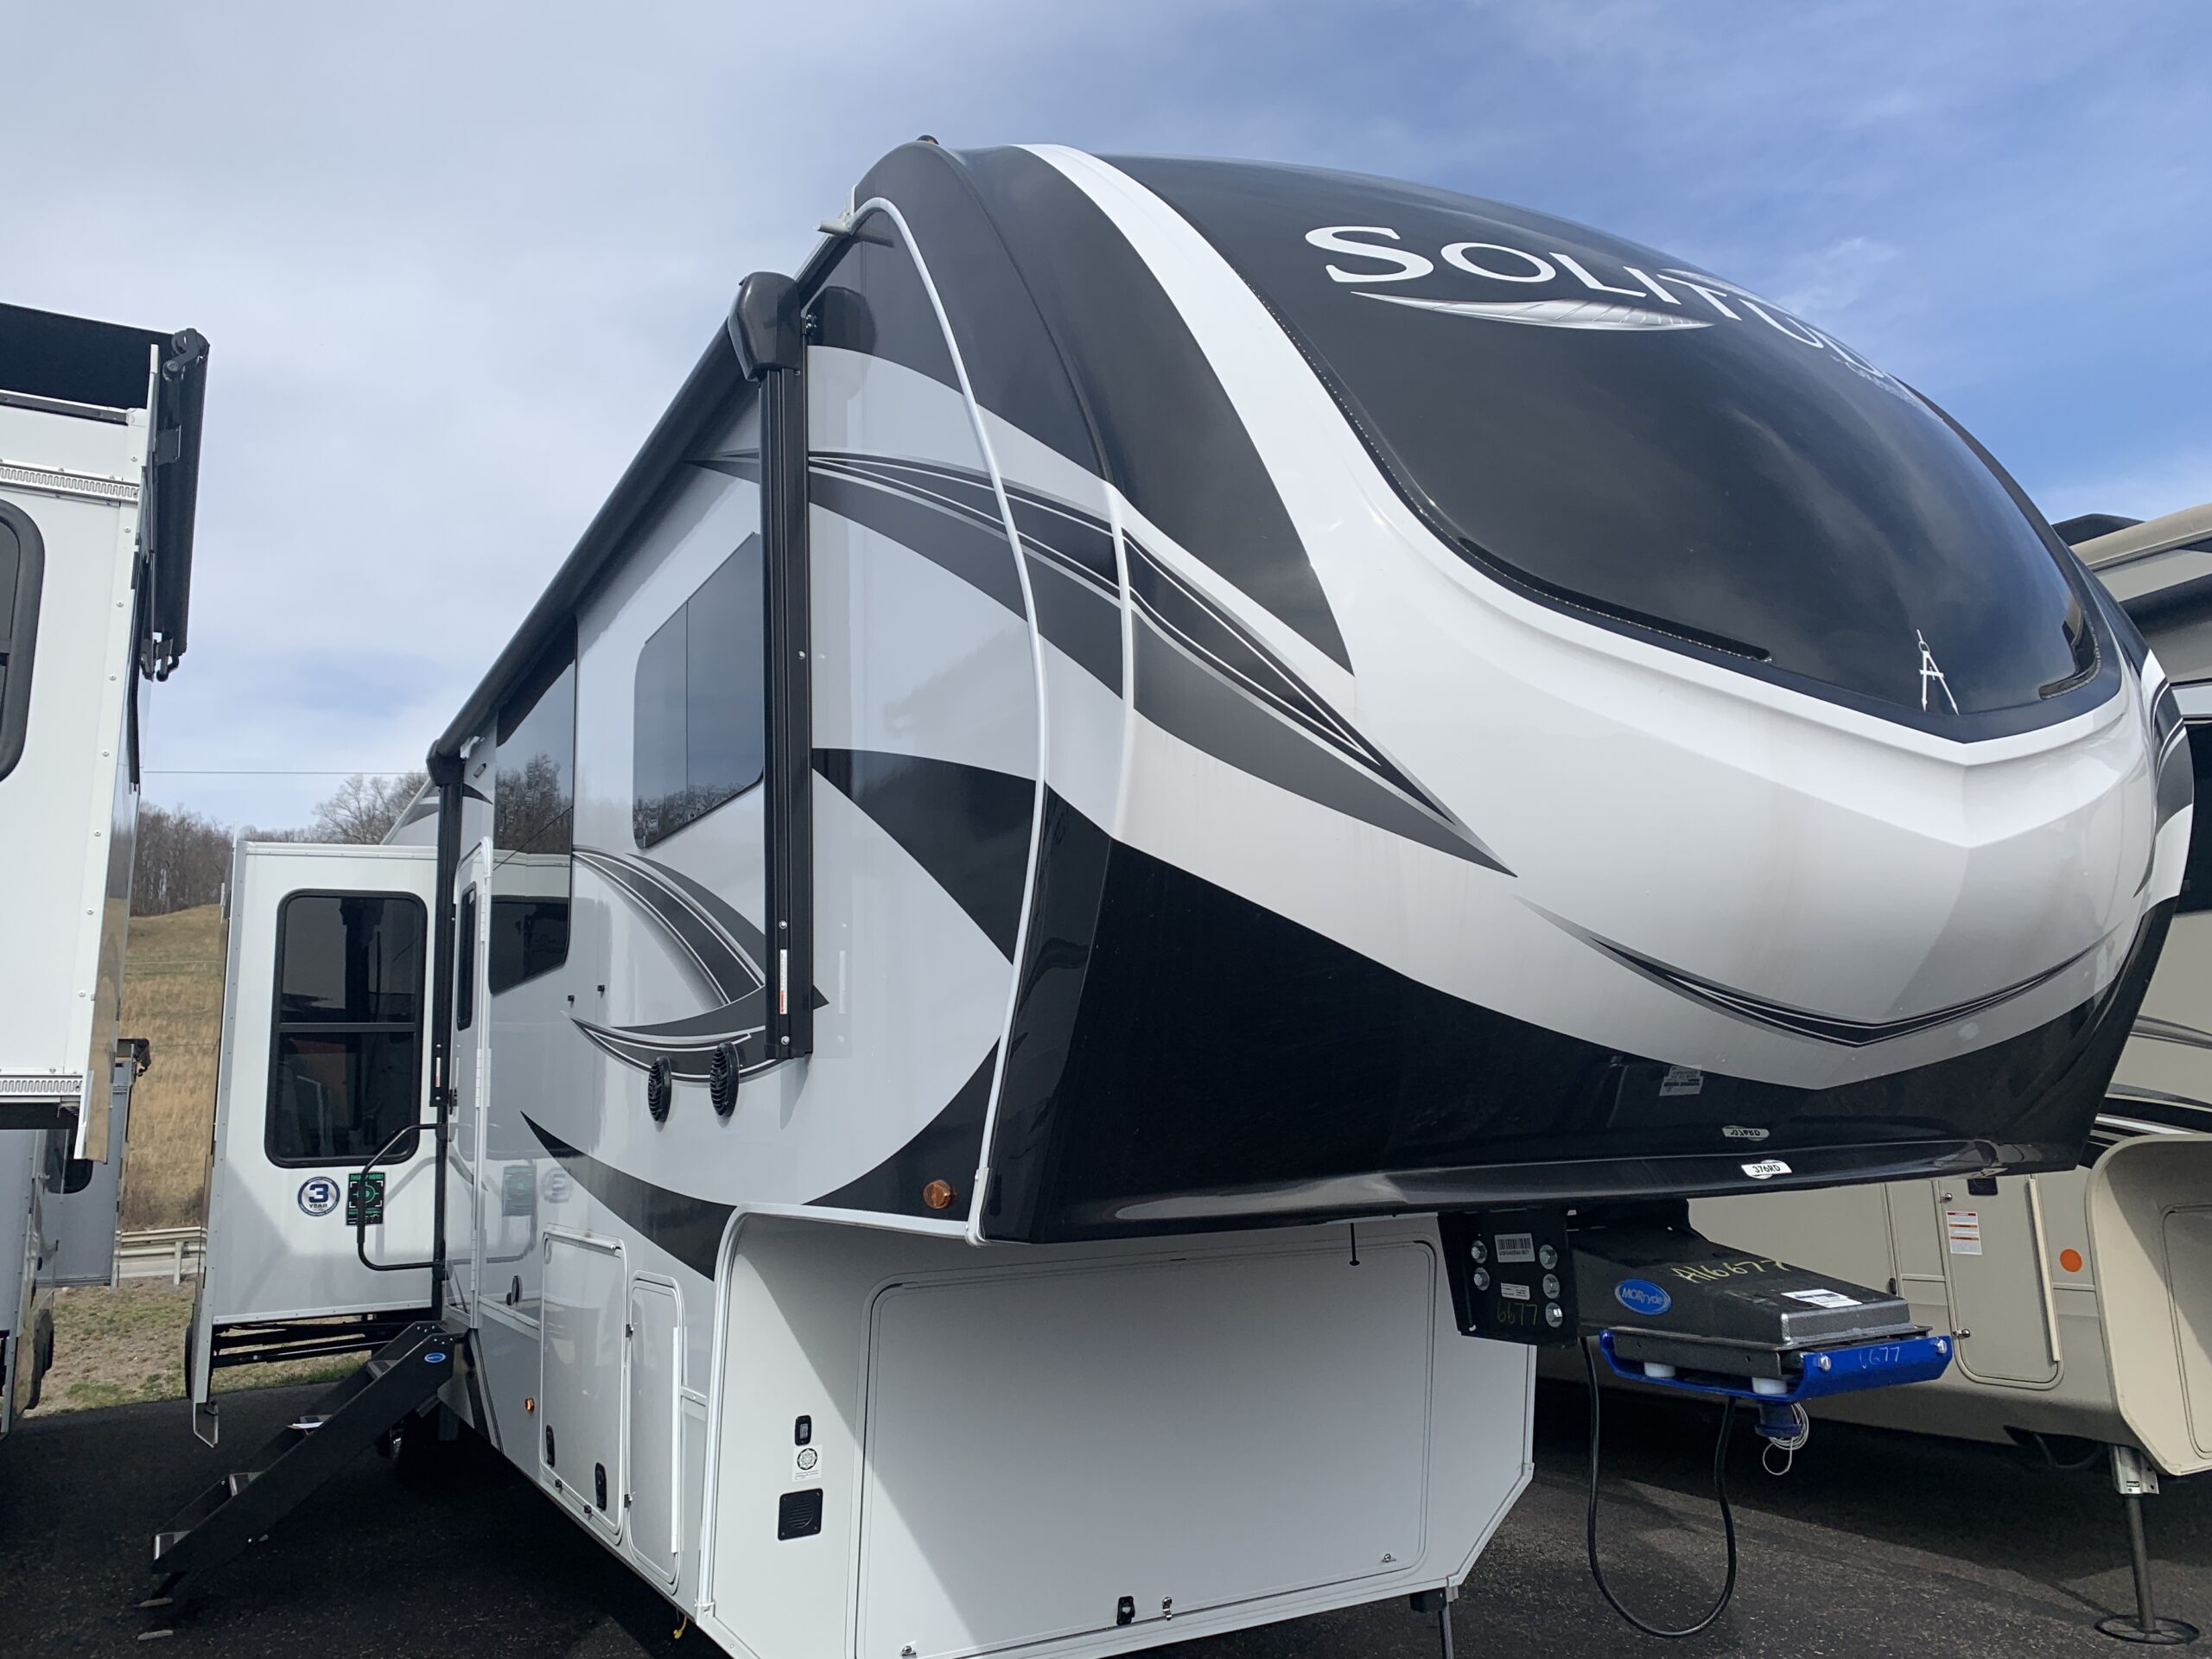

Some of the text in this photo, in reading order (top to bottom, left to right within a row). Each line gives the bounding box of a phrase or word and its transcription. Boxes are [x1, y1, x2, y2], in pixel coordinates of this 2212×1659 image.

[1751, 1164, 1781, 1173] 376RD
[308, 1183, 329, 1203] 3
[1497, 1299, 1538, 1326] 6677
